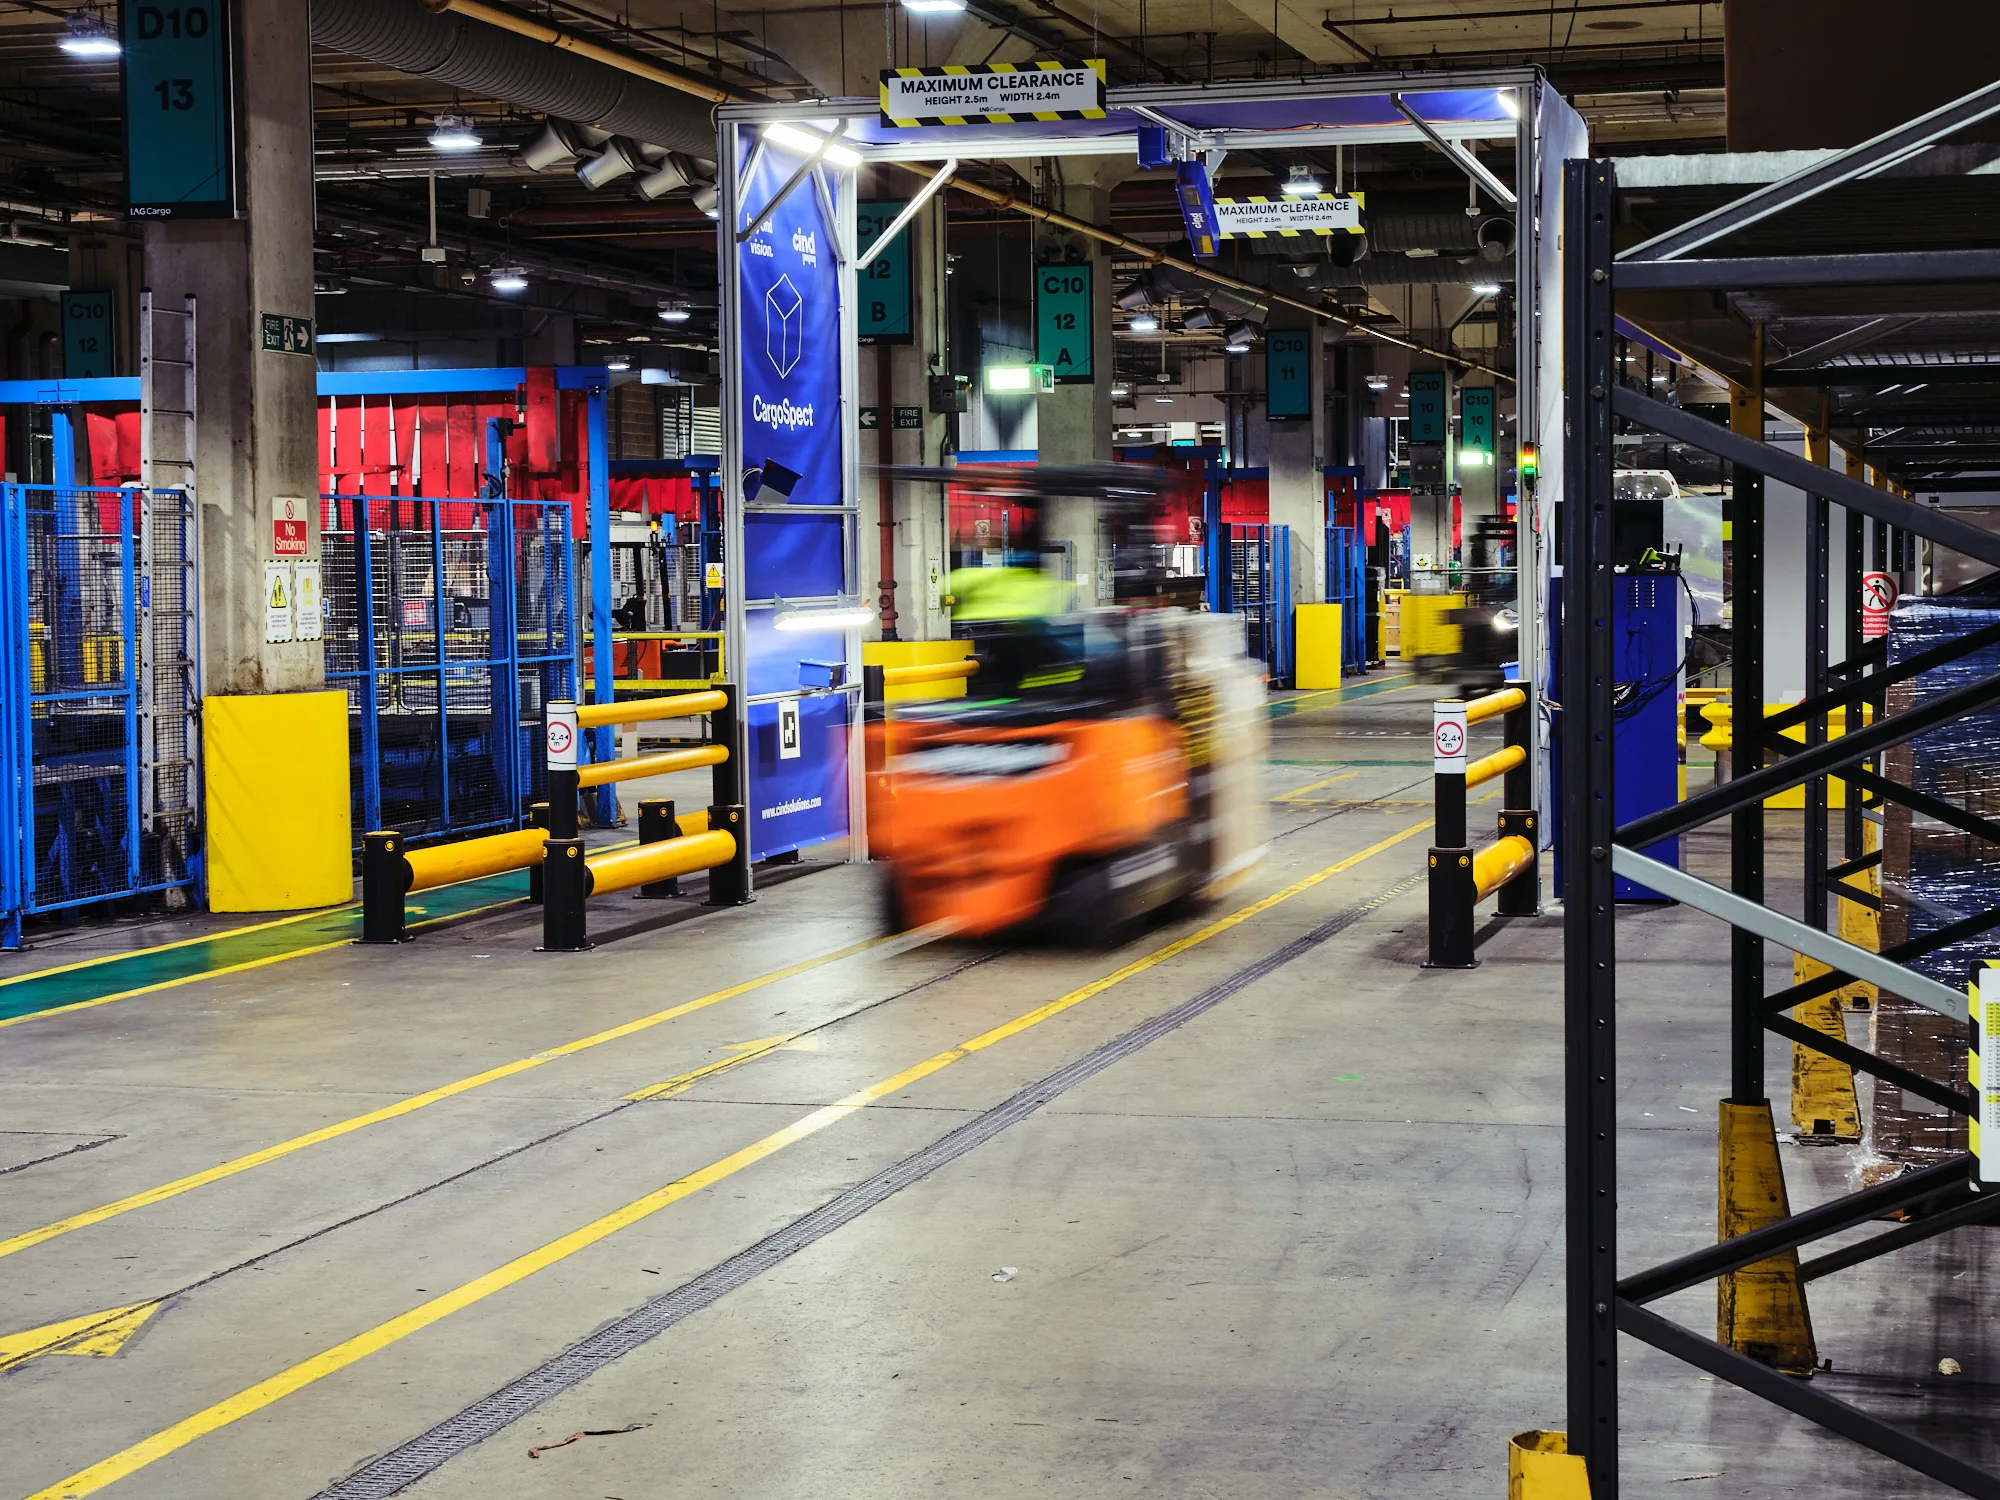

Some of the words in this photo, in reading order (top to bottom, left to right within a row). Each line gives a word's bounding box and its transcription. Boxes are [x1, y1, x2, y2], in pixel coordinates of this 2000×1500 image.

[137, 6, 208, 40] D10
[901, 76, 983, 94] MAXIMUM
[987, 73, 1085, 90] CLEARANCE
[154, 79, 194, 111] 13
[925, 95, 962, 106] HEIGHT
[964, 95, 988, 104] 2.5m
[999, 92, 1034, 102] WIDTH
[1036, 91, 1060, 101] 2.4m
[146, 207, 172, 217] Cargo
[1219, 205, 1278, 216] MAXIMUM
[1280, 201, 1349, 213] CLEARANCE
[750, 238, 774, 258] vision.
[792, 227, 816, 255] cind
[868, 260, 891, 279] 12
[1043, 276, 1084, 294] C10
[69, 303, 104, 319] C10
[871, 302, 887, 322] B
[265, 319, 280, 330] FIRE
[1053, 313, 1075, 330] 12
[78, 337, 98, 353] 12
[266, 334, 280, 346] EXIT
[1272, 339, 1304, 353] C10
[1056, 348, 1073, 365] A
[1281, 367, 1295, 380] 11
[1414, 380, 1440, 391] C10
[1420, 402, 1434, 413] 10
[1466, 395, 1489, 405] C10
[753, 394, 813, 431] CargoSpect
[1471, 415, 1485, 425] 10
[1473, 435, 1482, 445] A
[285, 522, 296, 537] No
[275, 536, 306, 554] Smoking
[550, 732, 564, 741] 2.4
[1441, 733, 1457, 742] 2.4
[761, 797, 822, 820] www.cindsolutions.com
